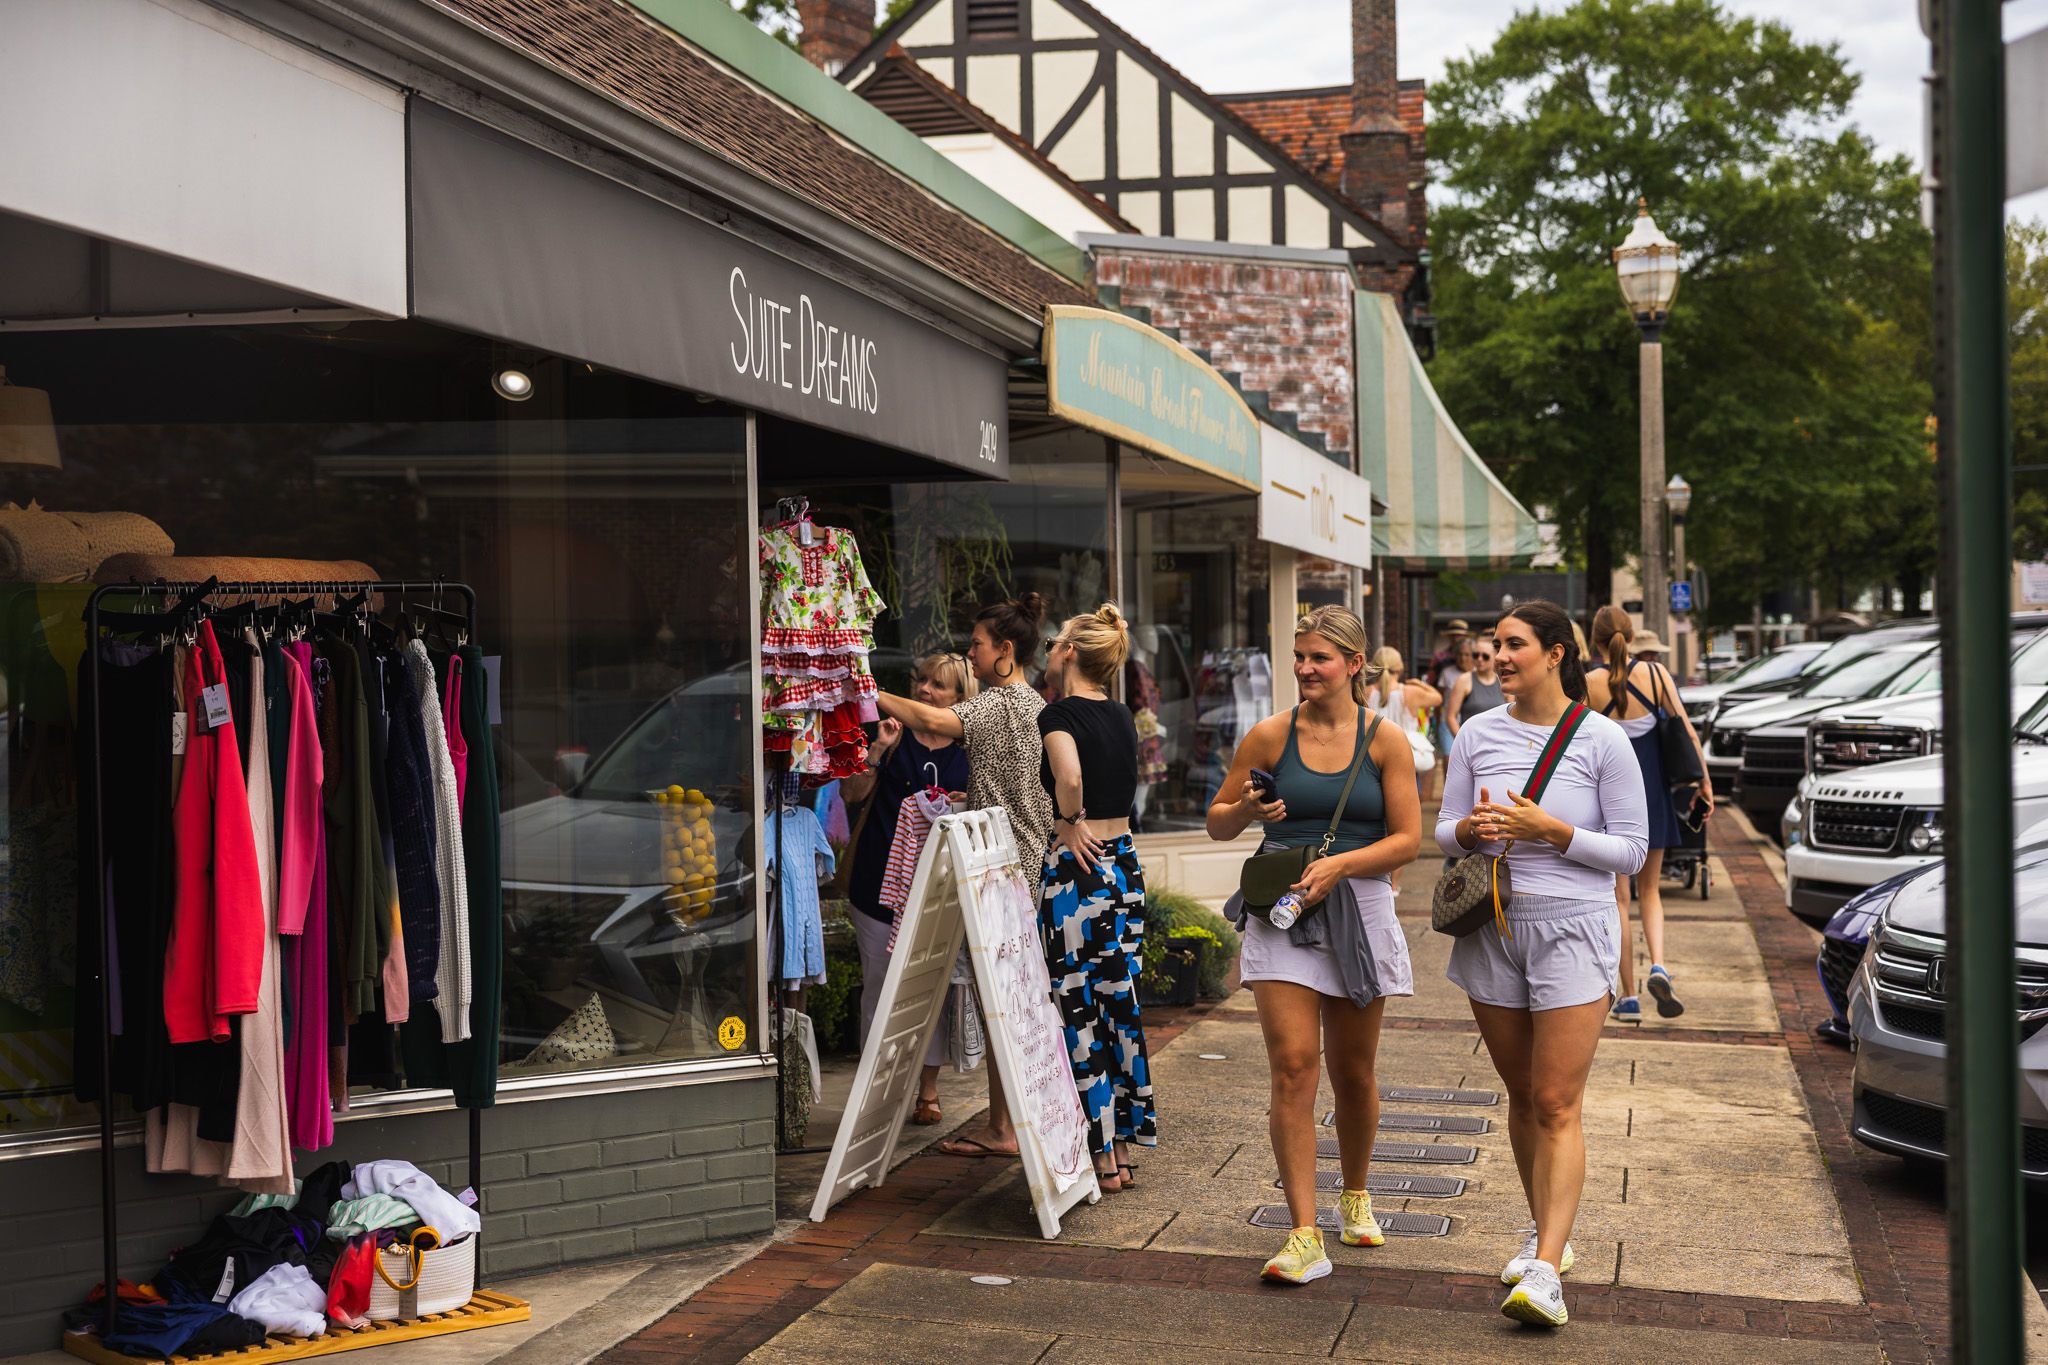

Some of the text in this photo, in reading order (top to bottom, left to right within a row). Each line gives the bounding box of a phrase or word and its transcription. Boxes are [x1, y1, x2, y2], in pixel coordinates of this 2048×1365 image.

[730, 266, 878, 414] SUITE DREAMS
[1836, 741, 1880, 760] GMC
[1818, 787, 1904, 799] LAND ROVER
